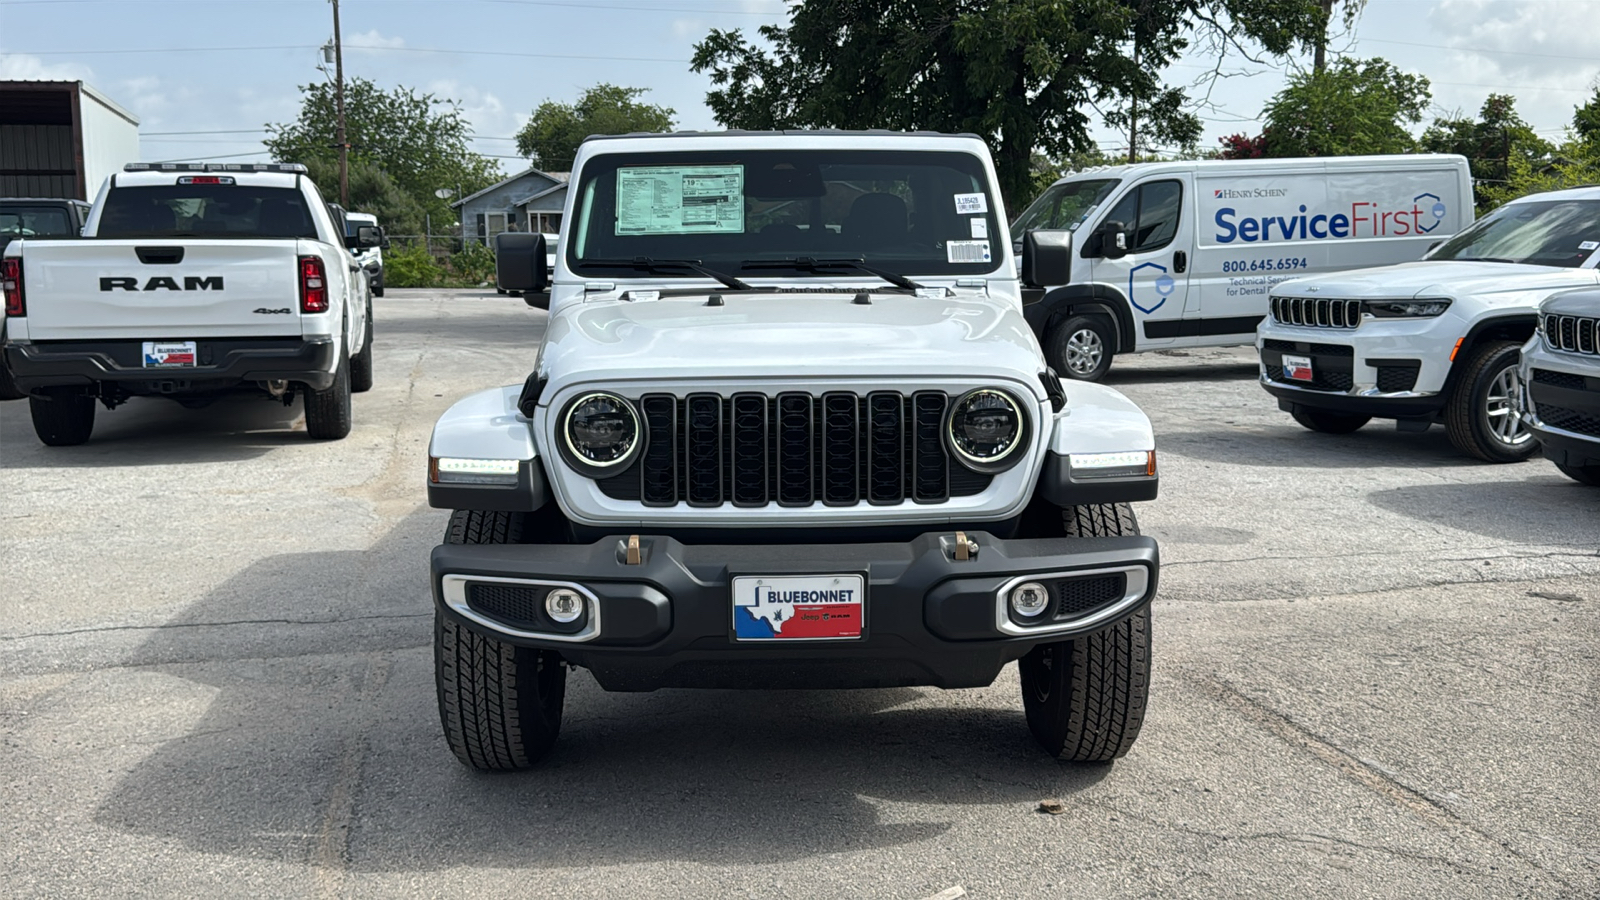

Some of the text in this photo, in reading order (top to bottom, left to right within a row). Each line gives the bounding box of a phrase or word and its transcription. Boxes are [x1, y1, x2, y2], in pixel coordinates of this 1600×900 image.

[1224, 189, 1253, 198] HENRY
[1222, 257, 1307, 272] 800.645.6594
[99, 276, 224, 291] RAM
[1229, 276, 1266, 286] Technical
[1226, 287, 1238, 296] for
[1240, 286, 1266, 296] Dental
[252, 307, 292, 315] 4x4
[768, 590, 853, 603] BLUEBONNET
[801, 613, 820, 622] Jeep
